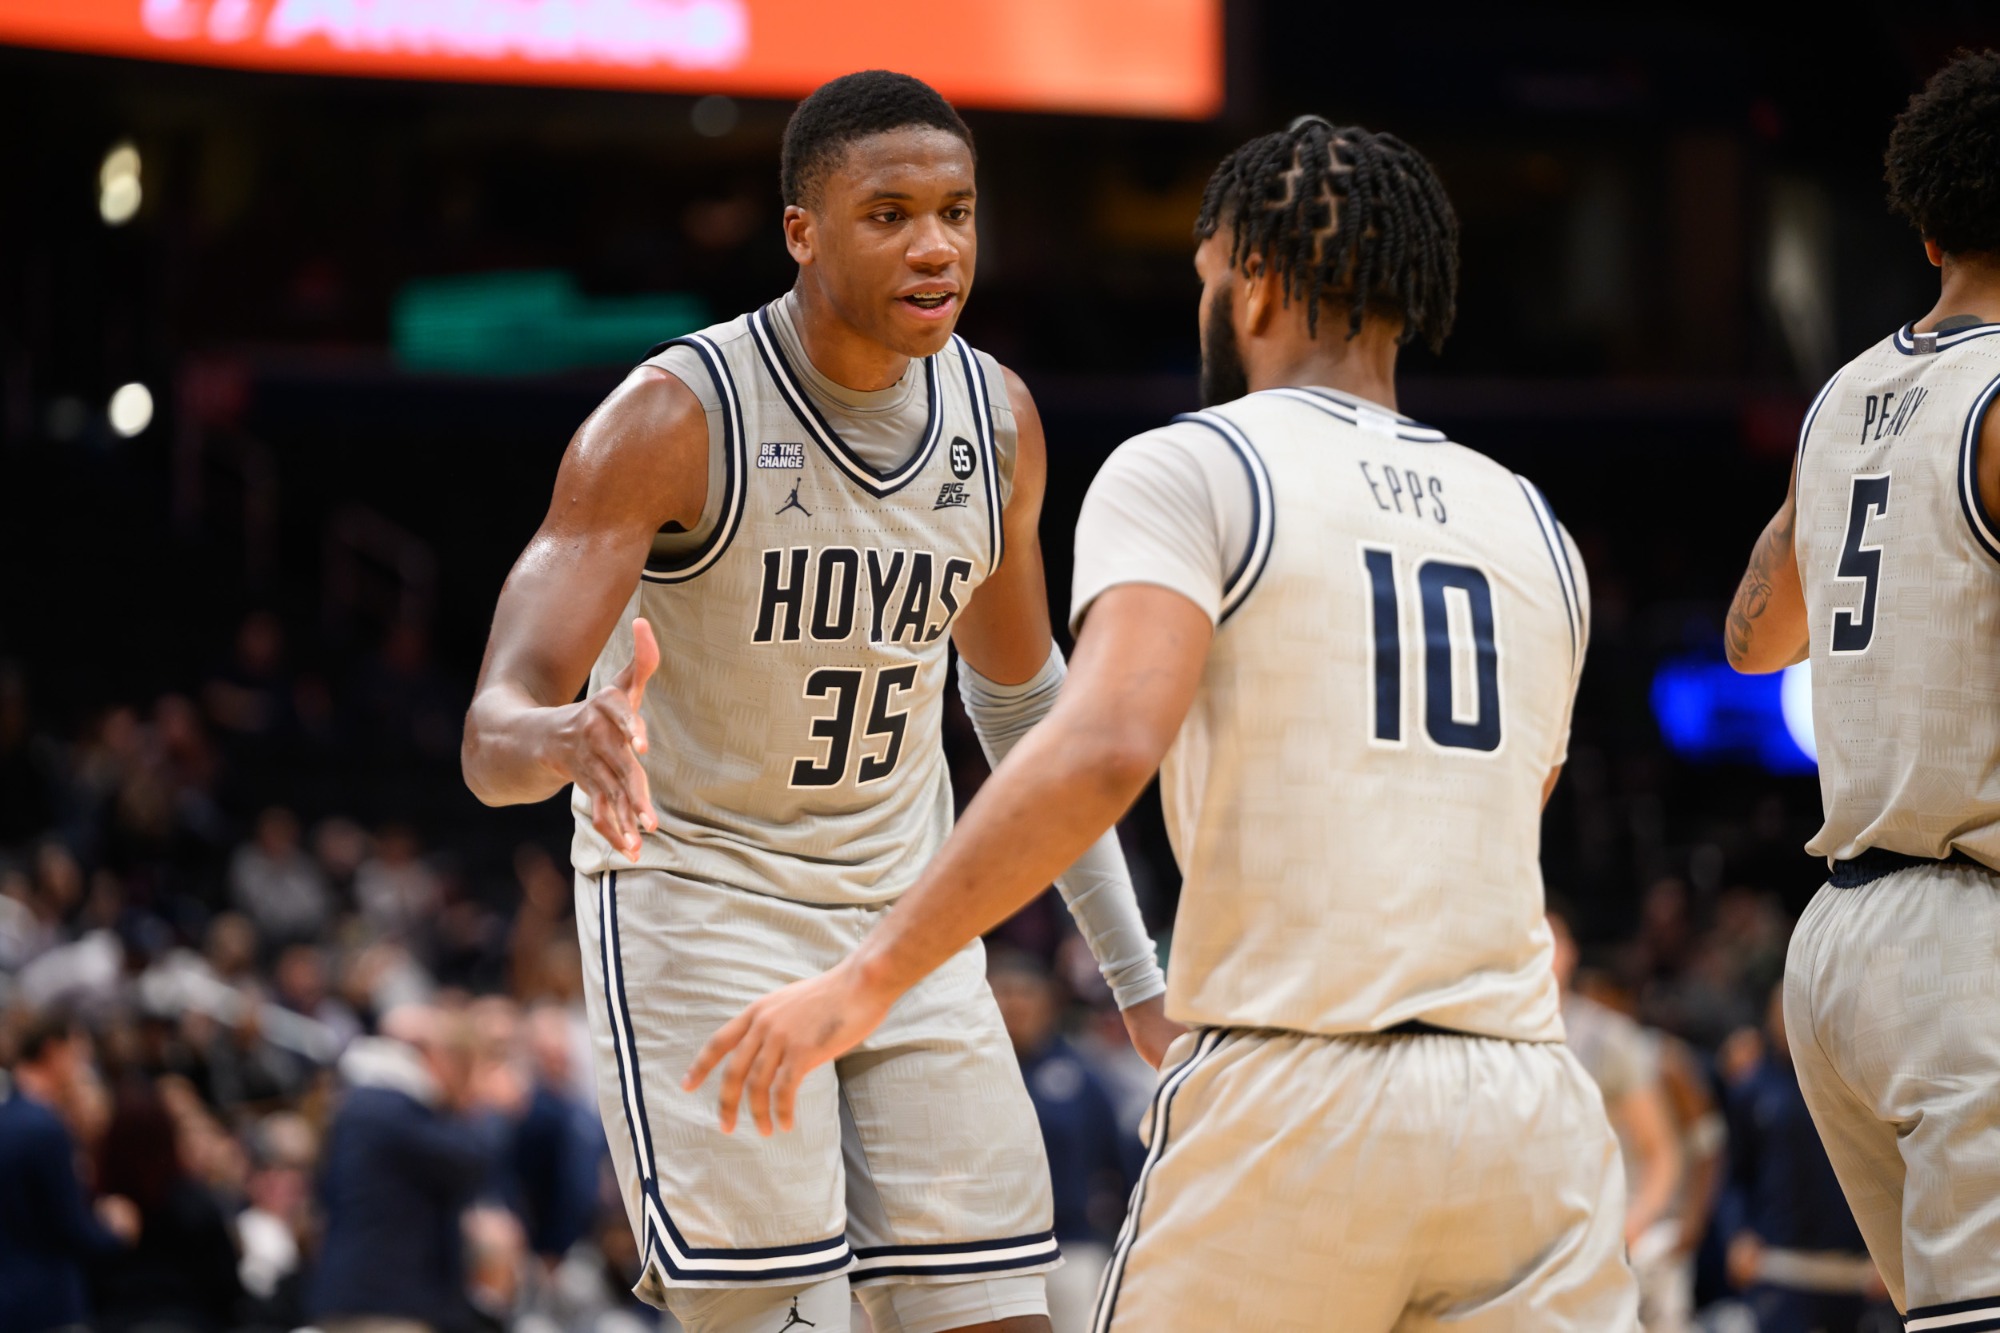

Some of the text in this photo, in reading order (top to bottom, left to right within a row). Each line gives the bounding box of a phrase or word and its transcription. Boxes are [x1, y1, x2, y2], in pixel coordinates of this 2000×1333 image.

[757, 455, 804, 468] CHANGE
[761, 443, 802, 456] BE THE
[952, 444, 971, 472] 55
[935, 493, 971, 505] EAST
[940, 482, 965, 494] BIG
[1359, 461, 1447, 525] EPPS
[1830, 471, 1892, 656] 5
[751, 546, 974, 645] HOYAS
[1357, 540, 1504, 759] 10
[787, 661, 921, 789] 35
